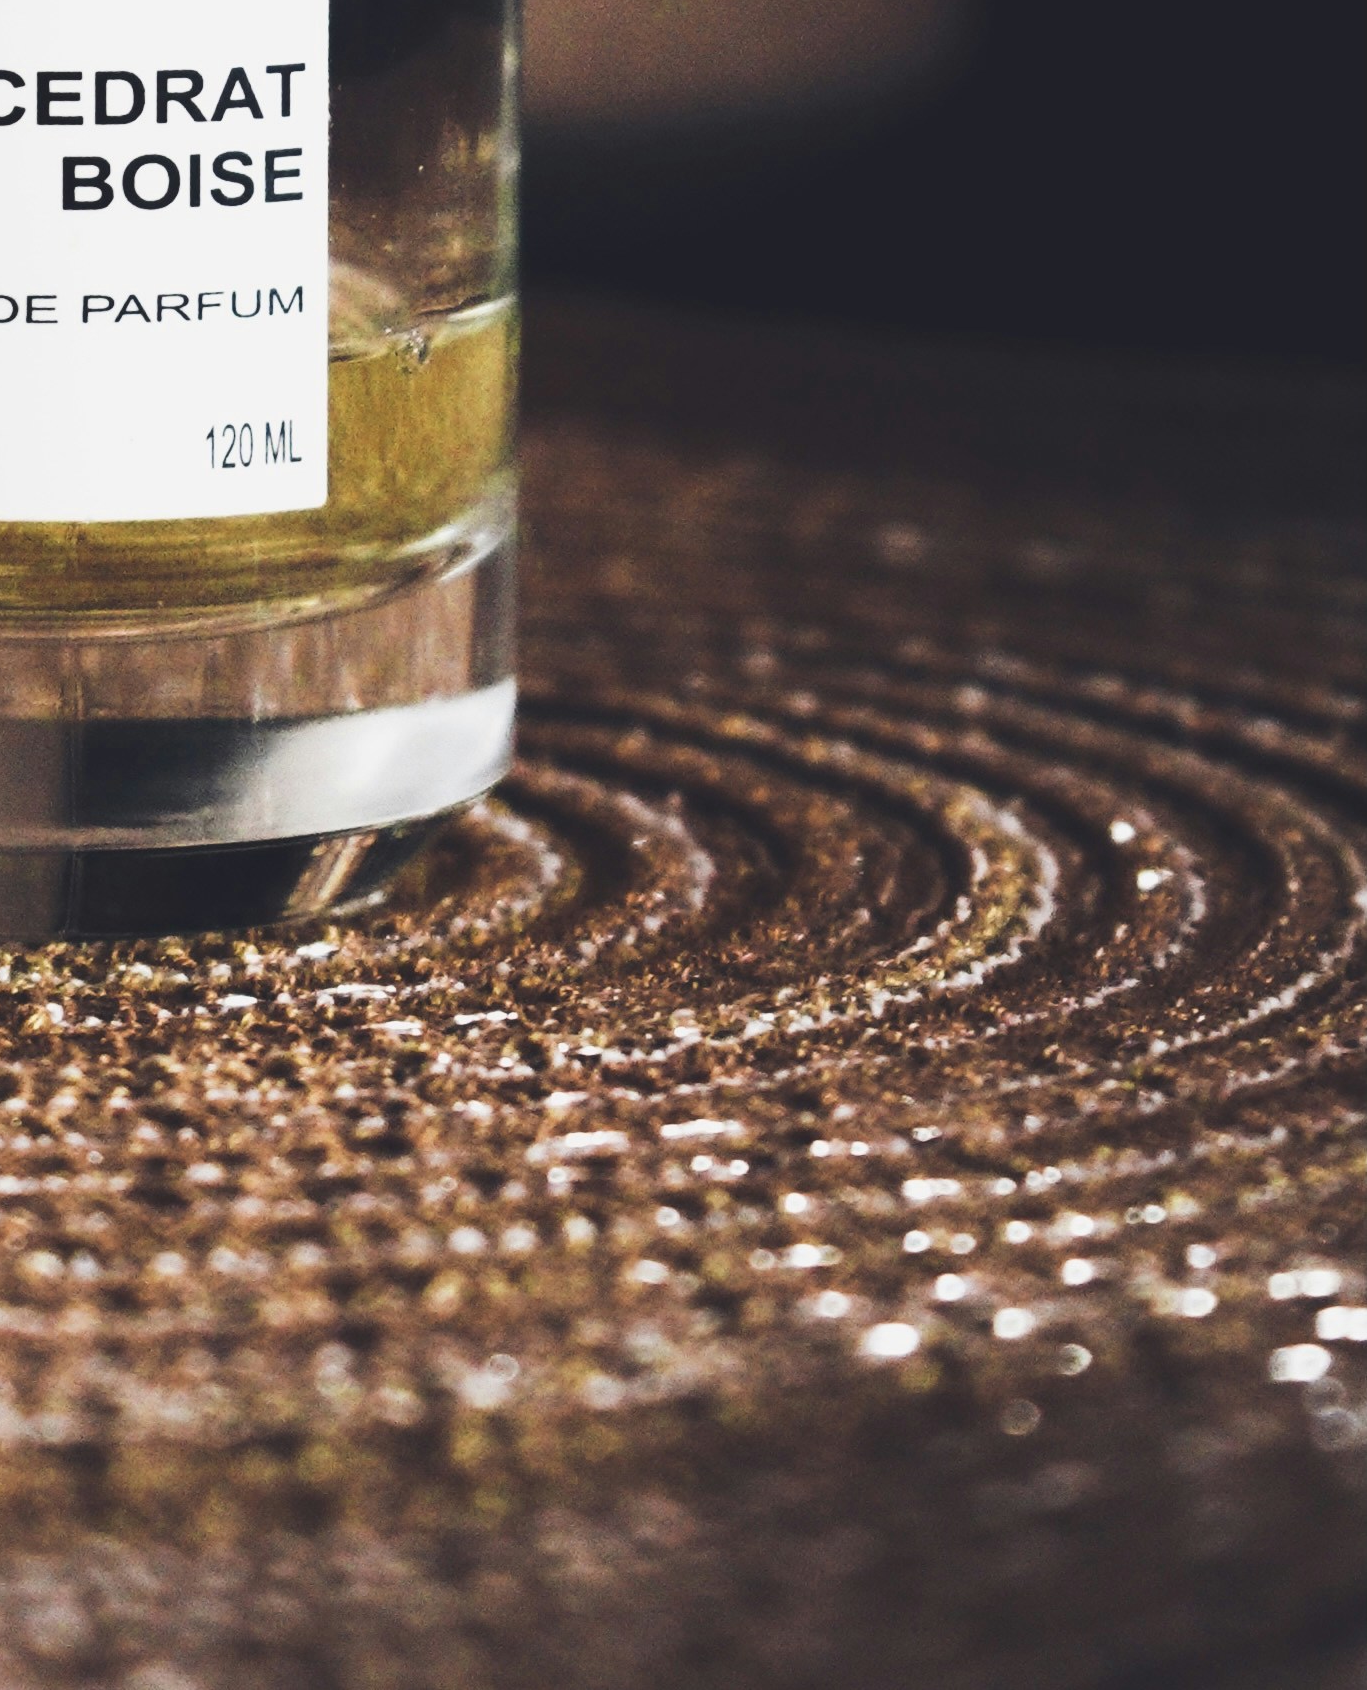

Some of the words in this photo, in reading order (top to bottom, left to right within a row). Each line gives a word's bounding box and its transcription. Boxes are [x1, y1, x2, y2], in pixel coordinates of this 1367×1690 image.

[61, 147, 304, 211] BOISE
[81, 285, 304, 324] PARFUM
[205, 423, 255, 469] 120
[264, 419, 303, 465] ML
